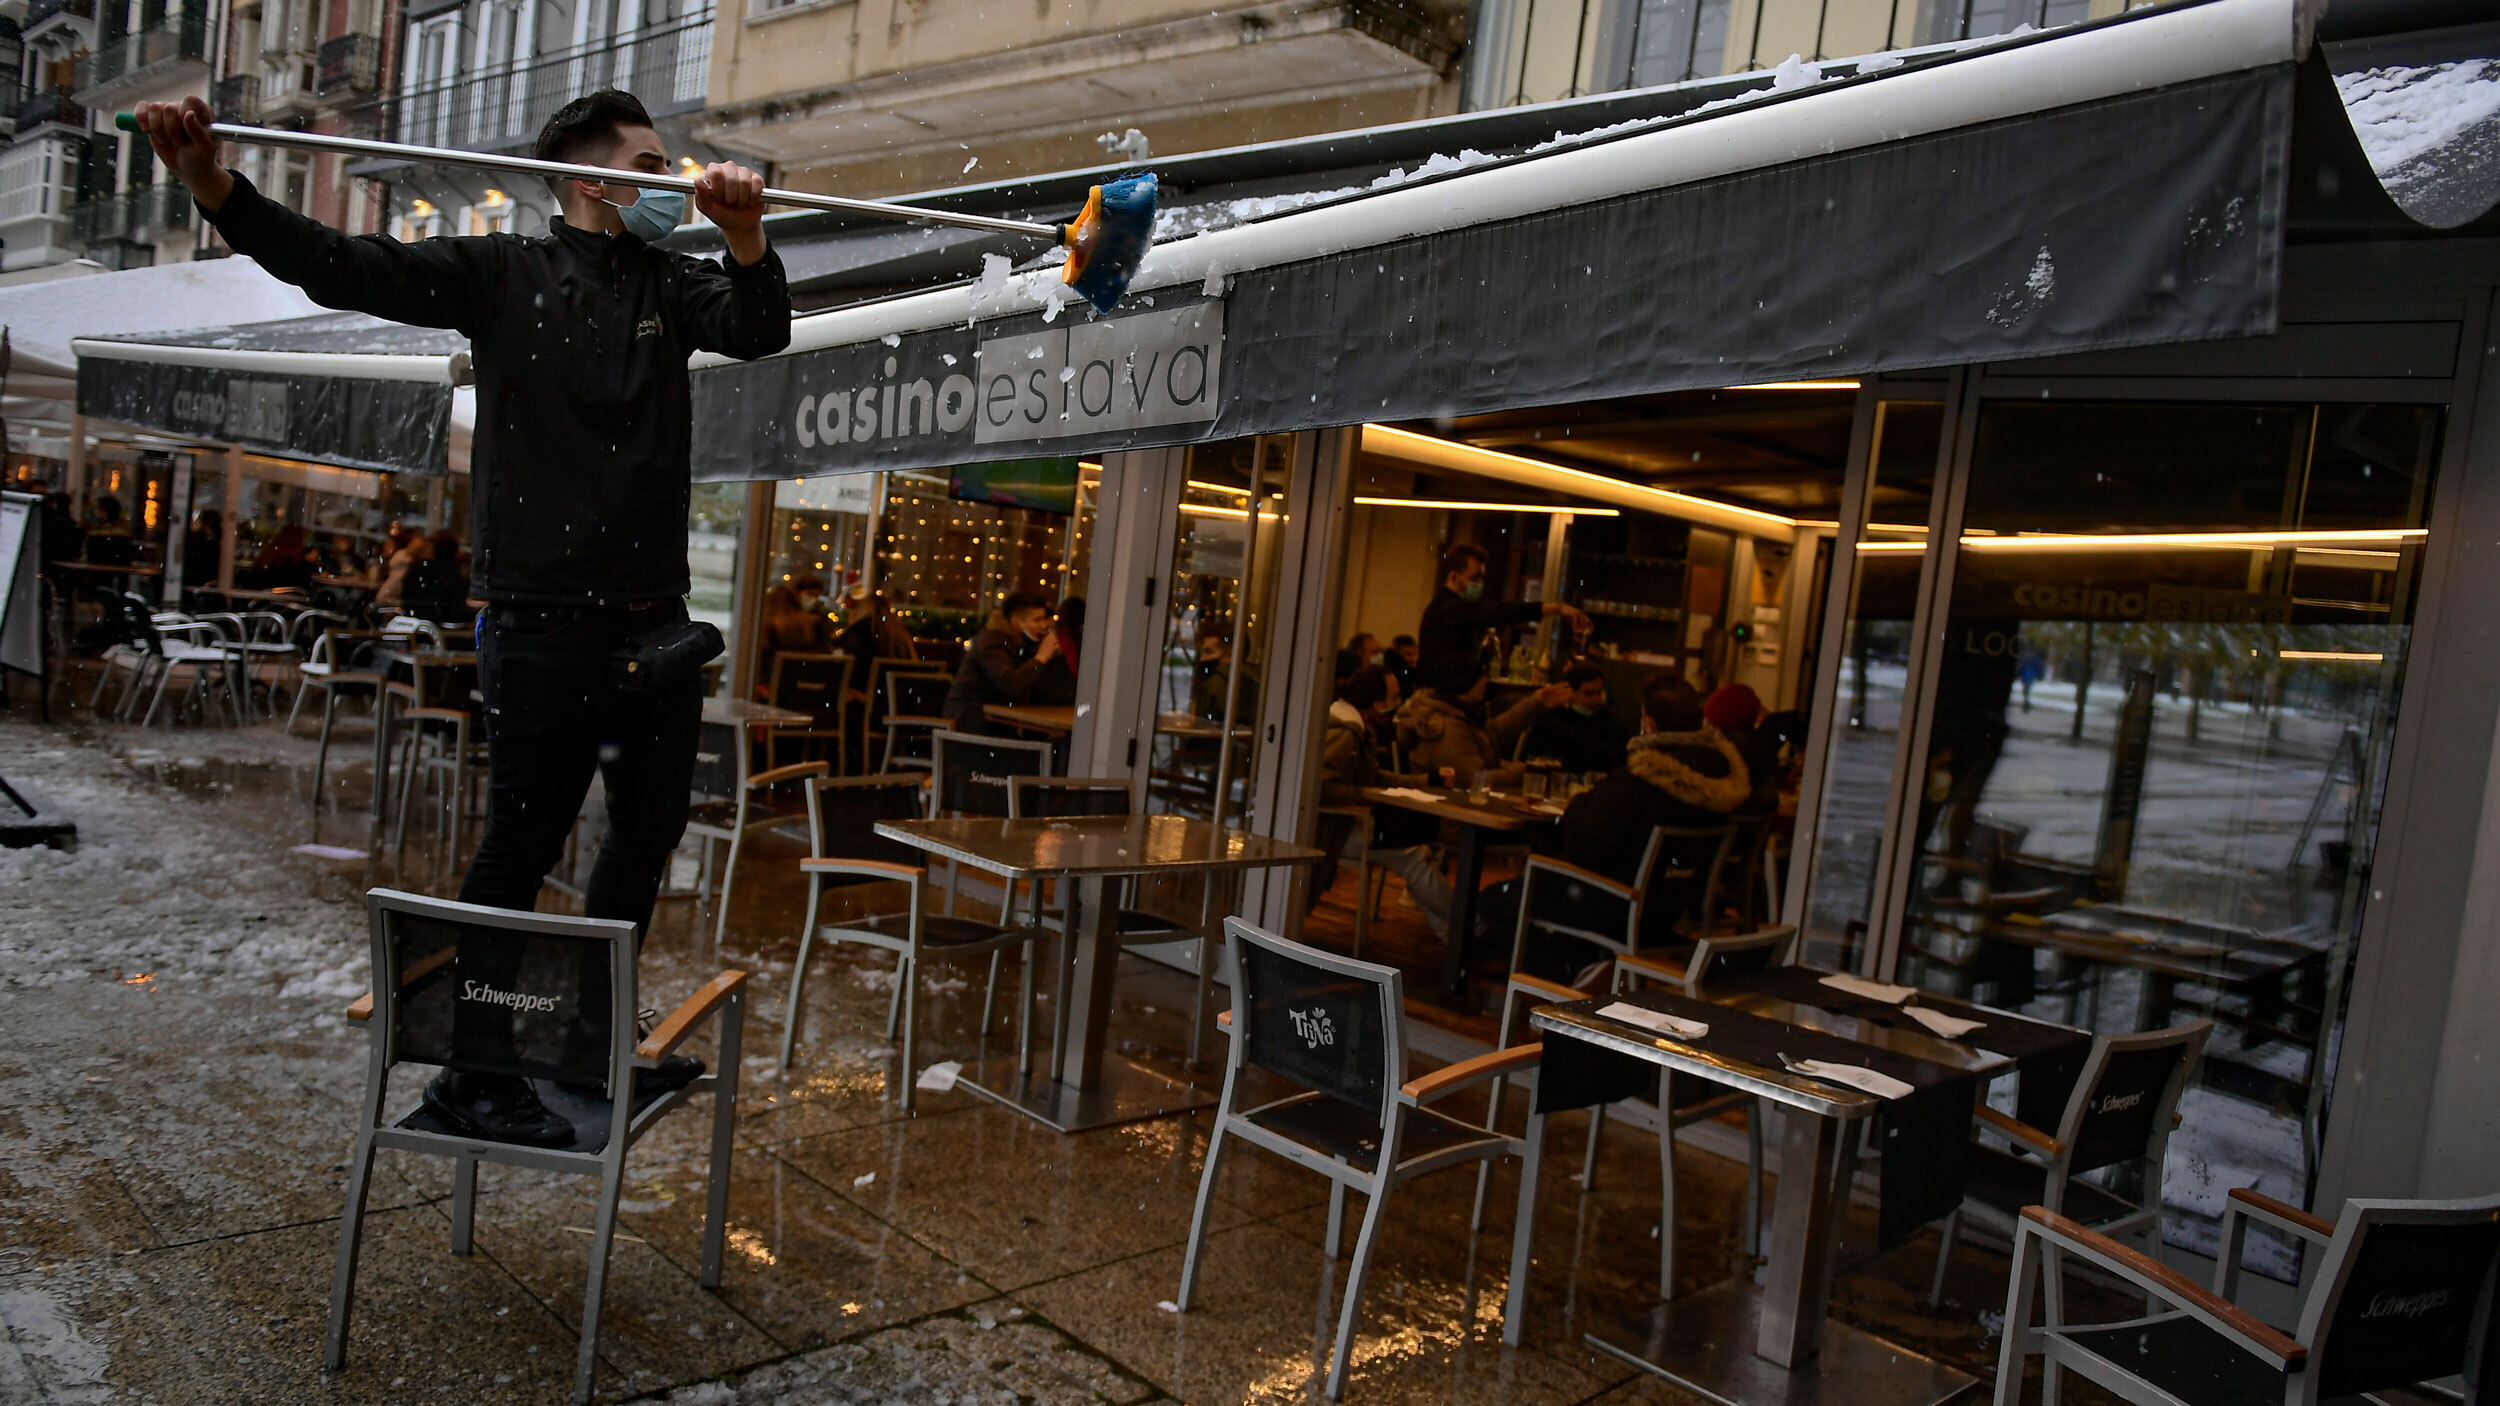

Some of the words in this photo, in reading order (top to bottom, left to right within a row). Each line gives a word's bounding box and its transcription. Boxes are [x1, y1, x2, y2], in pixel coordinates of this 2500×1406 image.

[795, 355, 974, 448] casino
[986, 326, 1209, 428] eslava
[2013, 578, 2145, 617] casino
[969, 770, 1007, 787] Schwepp
[460, 979, 556, 1013] Schweppes
[2360, 1290, 2451, 1319] Schweppes
